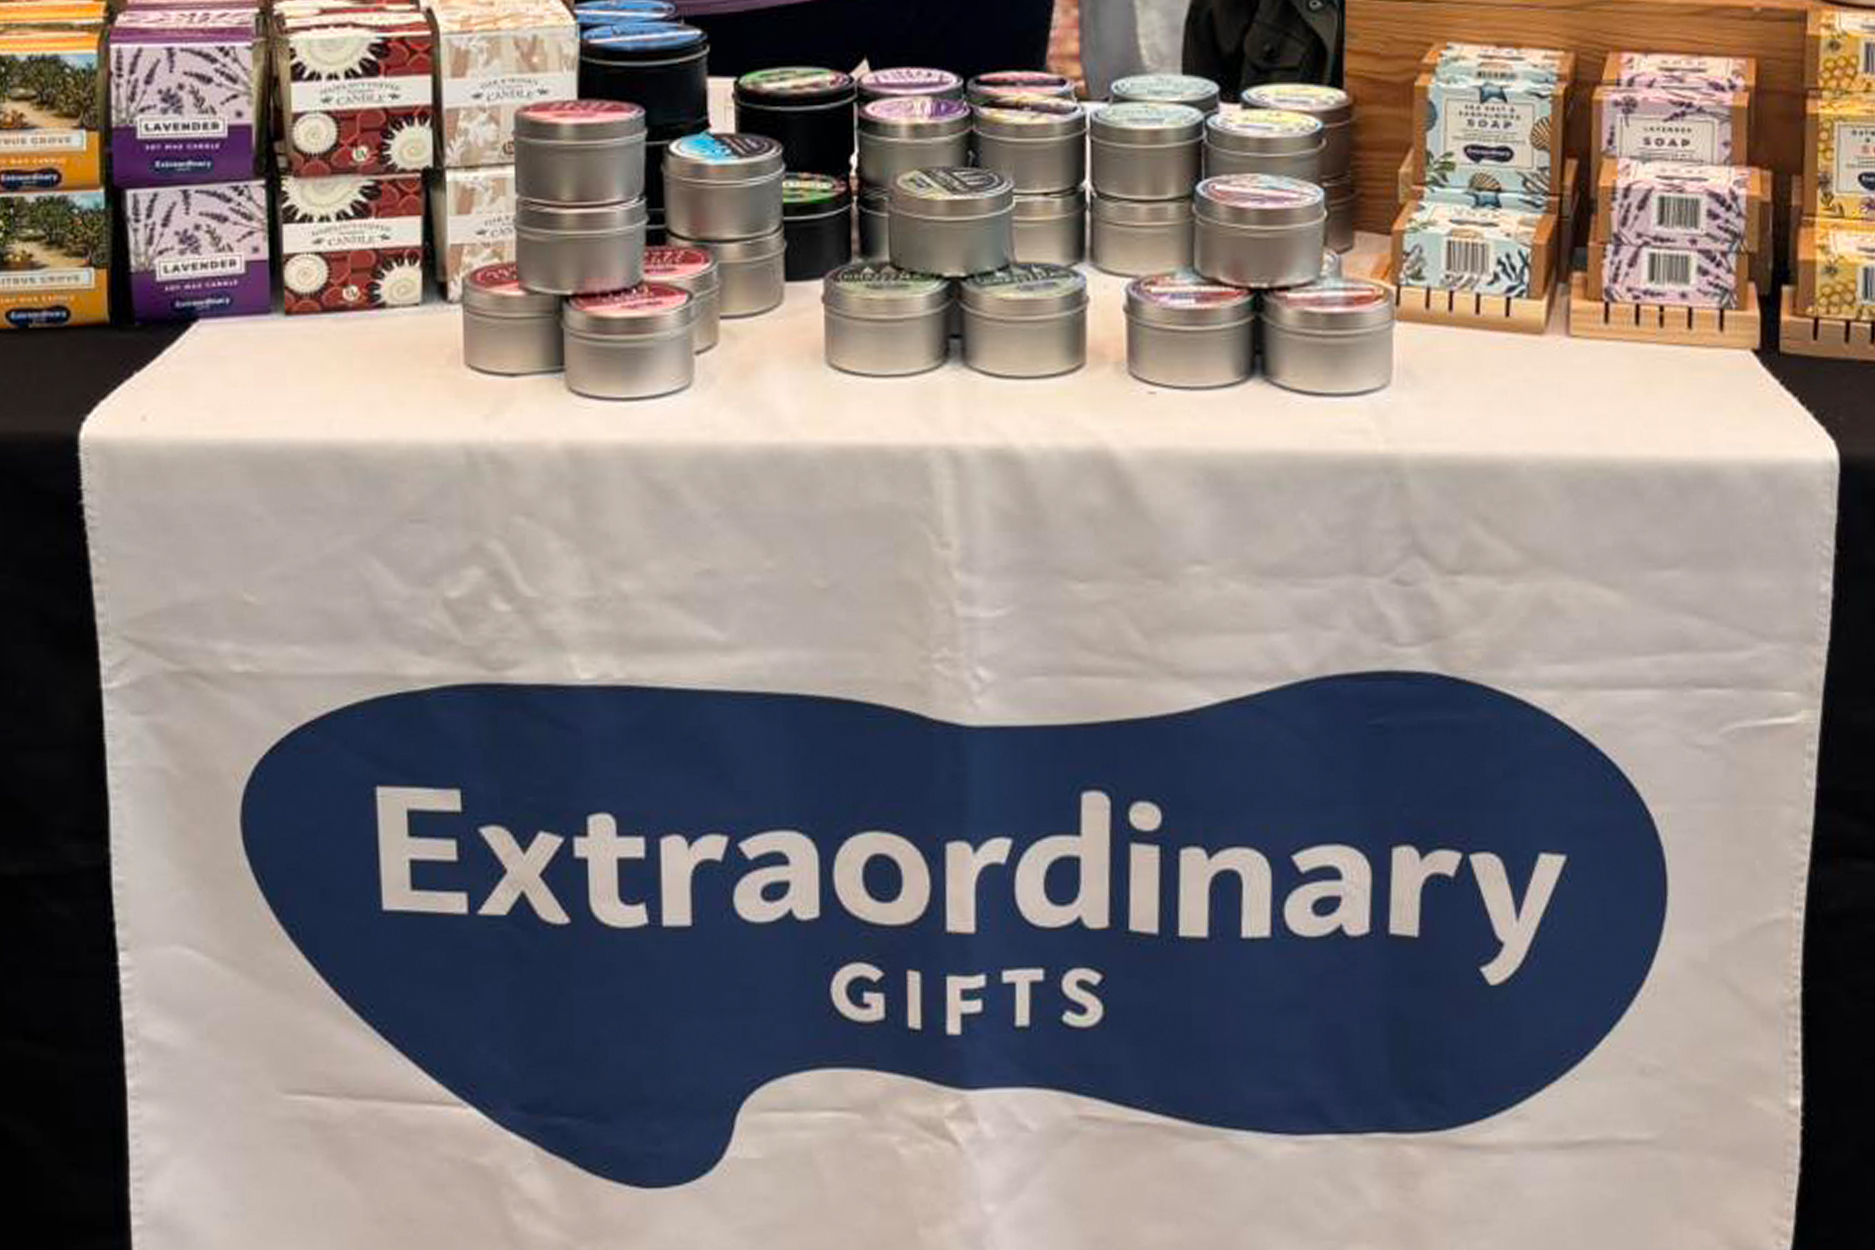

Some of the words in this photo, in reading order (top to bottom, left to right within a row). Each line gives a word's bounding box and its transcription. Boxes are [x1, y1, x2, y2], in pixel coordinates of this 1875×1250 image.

[144, 121, 220, 132] LAVENDER
[1466, 118, 1513, 130] SOAP
[1642, 136, 1691, 147] SOAP
[162, 258, 237, 274] LAVENDER
[375, 786, 1566, 986] Extraordinary
[830, 962, 1105, 1036] GIFTS
